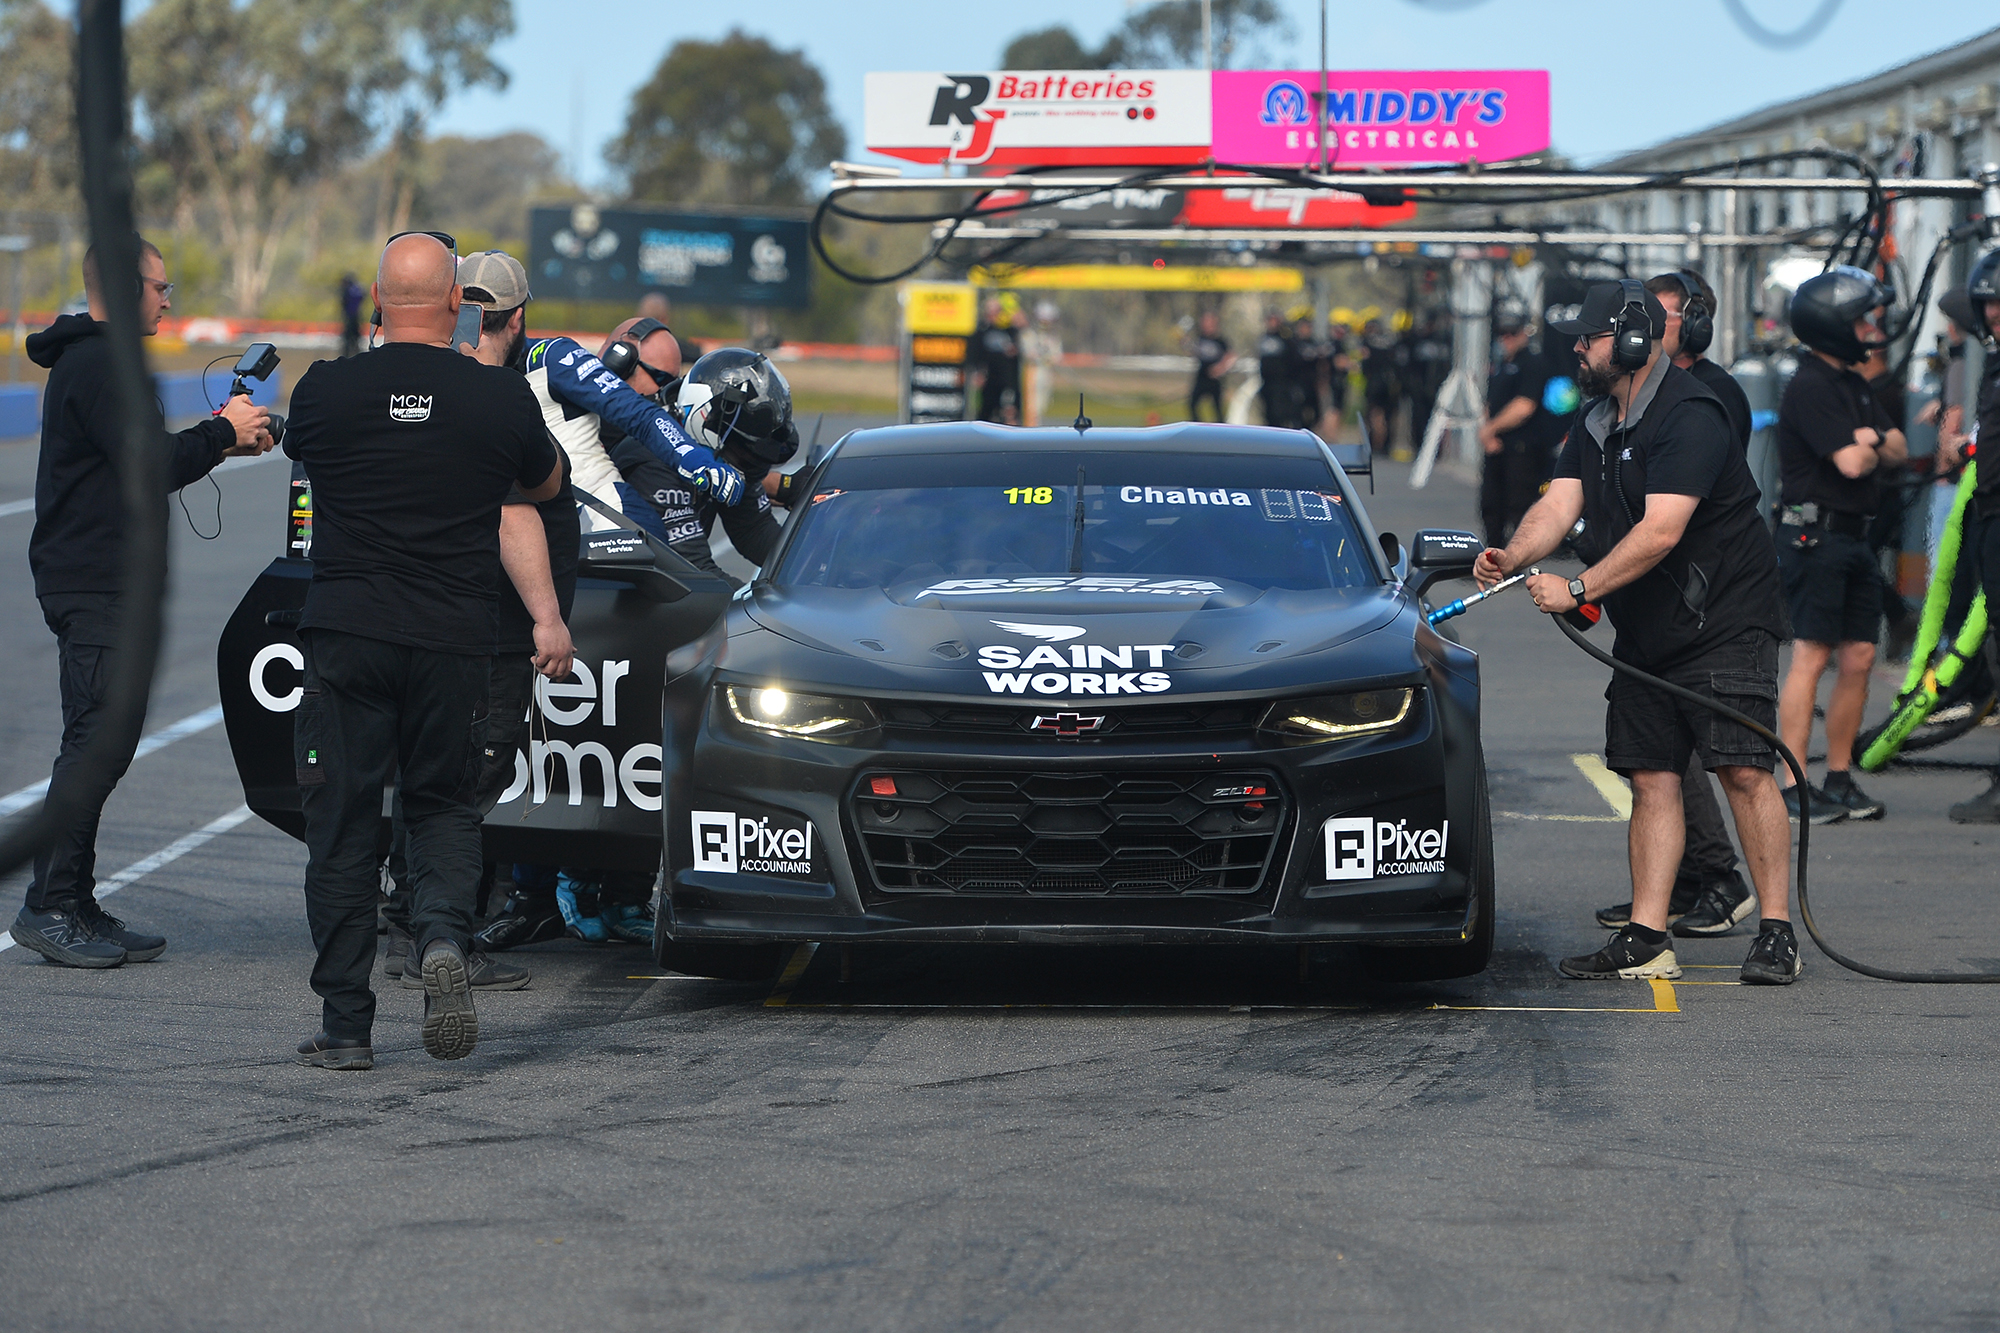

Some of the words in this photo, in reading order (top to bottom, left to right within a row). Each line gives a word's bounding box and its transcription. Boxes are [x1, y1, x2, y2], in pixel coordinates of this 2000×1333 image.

[998, 73, 1156, 99] Batteries
[1325, 91, 1505, 124] MIDDY'S
[1286, 130, 1480, 150] ELECTRICAL
[391, 394, 433, 407] MCM
[1003, 487, 1053, 505] 118
[1121, 486, 1252, 507] Chahda
[1441, 541, 1469, 549] Service
[1452, 535, 1479, 543] Courier
[606, 546, 634, 554] Service
[982, 672, 1173, 695] WORKS
[1213, 786, 1254, 797] ZL1
[739, 816, 813, 860] Pixel
[1376, 818, 1449, 861] Pixel
[740, 859, 812, 874] ACCOUNTANTS
[1376, 860, 1446, 875] ACCOUNTANTS
